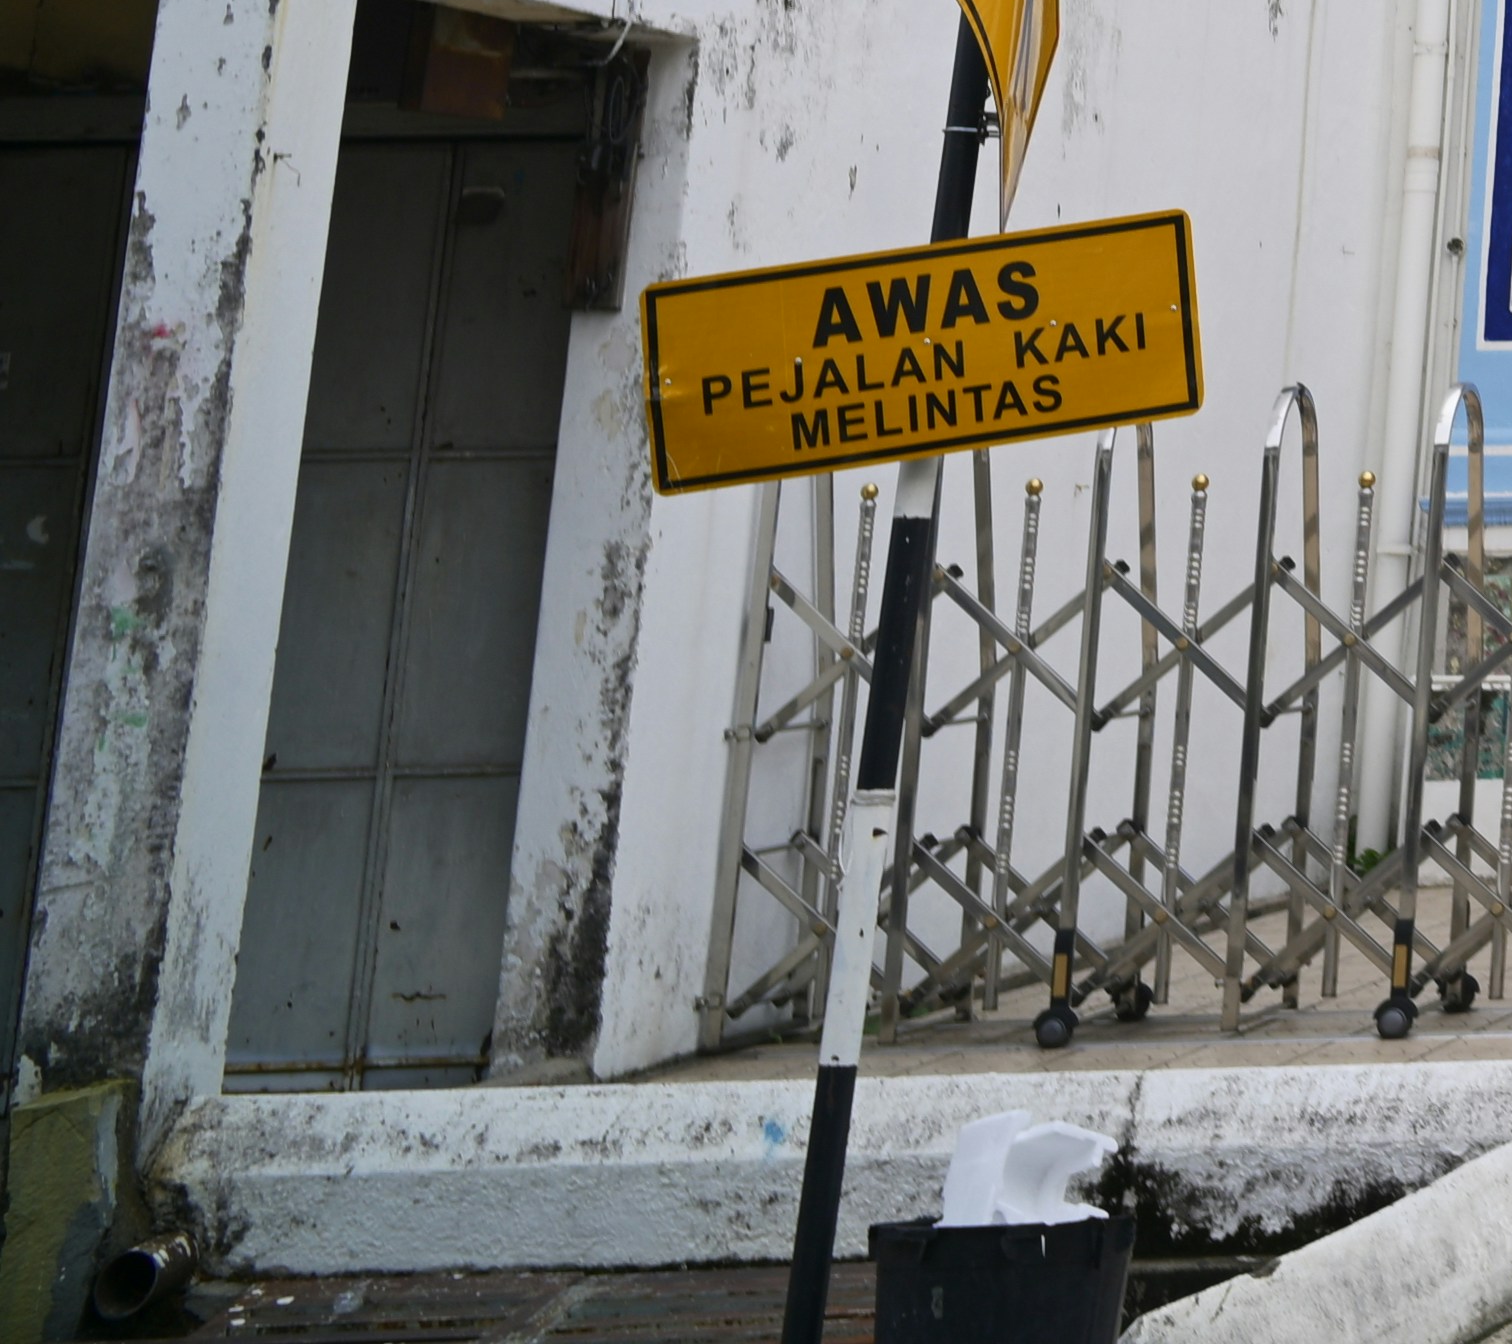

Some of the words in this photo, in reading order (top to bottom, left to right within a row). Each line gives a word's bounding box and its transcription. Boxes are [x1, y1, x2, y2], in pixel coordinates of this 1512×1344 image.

[811, 261, 1040, 349] AWAS
[701, 339, 966, 416] PEJALAN
[1013, 311, 1148, 370] KAKI
[791, 373, 1064, 452] MELINTAS
